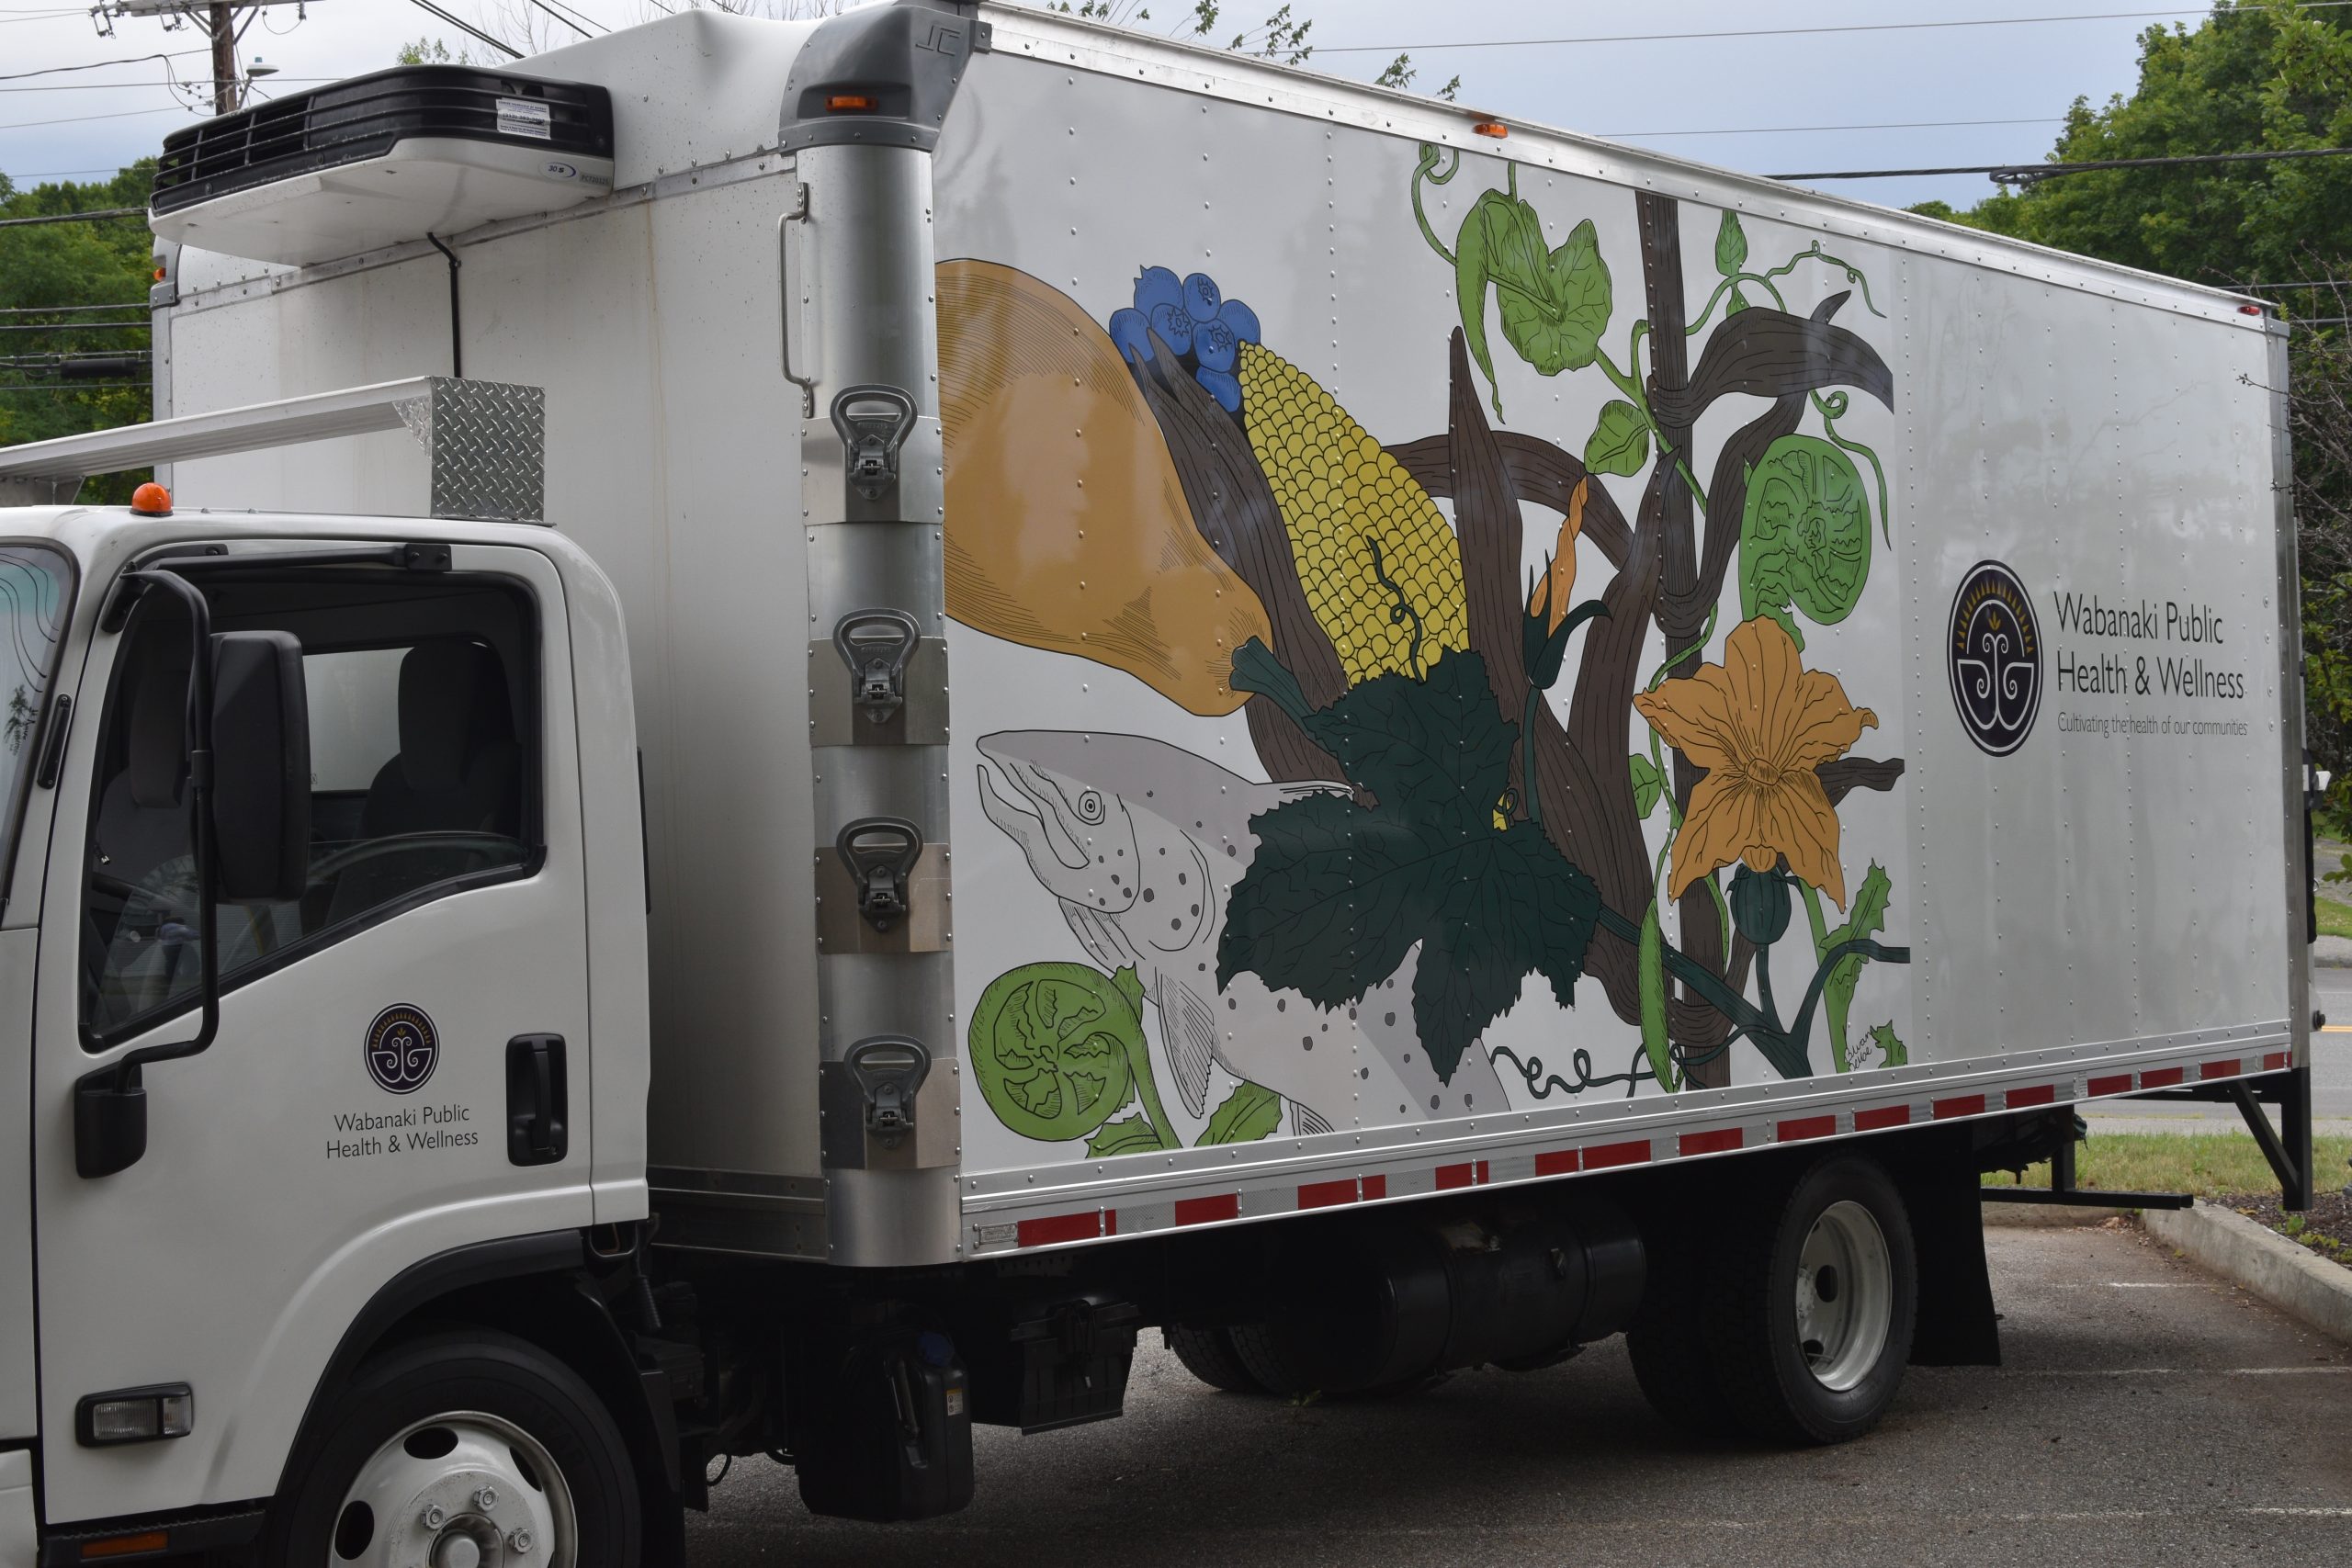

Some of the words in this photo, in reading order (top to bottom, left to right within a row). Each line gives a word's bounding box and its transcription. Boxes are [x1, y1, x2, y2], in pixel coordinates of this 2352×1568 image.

[2052, 591, 2159, 640] Wabanaki
[2165, 601, 2224, 645] Public
[2057, 649, 2128, 695] Health
[2134, 655, 2152, 696] &
[2155, 656, 2245, 700] Wellness
[2057, 711, 2109, 739] Cultivating
[2111, 714, 2127, 734] the
[2129, 714, 2158, 734] health
[2162, 715, 2172, 735] of
[2174, 721, 2190, 735] our
[2192, 720, 2248, 736] communities
[334, 1108, 416, 1133] Wabanaki
[424, 1103, 470, 1125] Public
[327, 1136, 381, 1159] Health
[389, 1134, 401, 1153] &
[406, 1130, 479, 1151] Wellness
